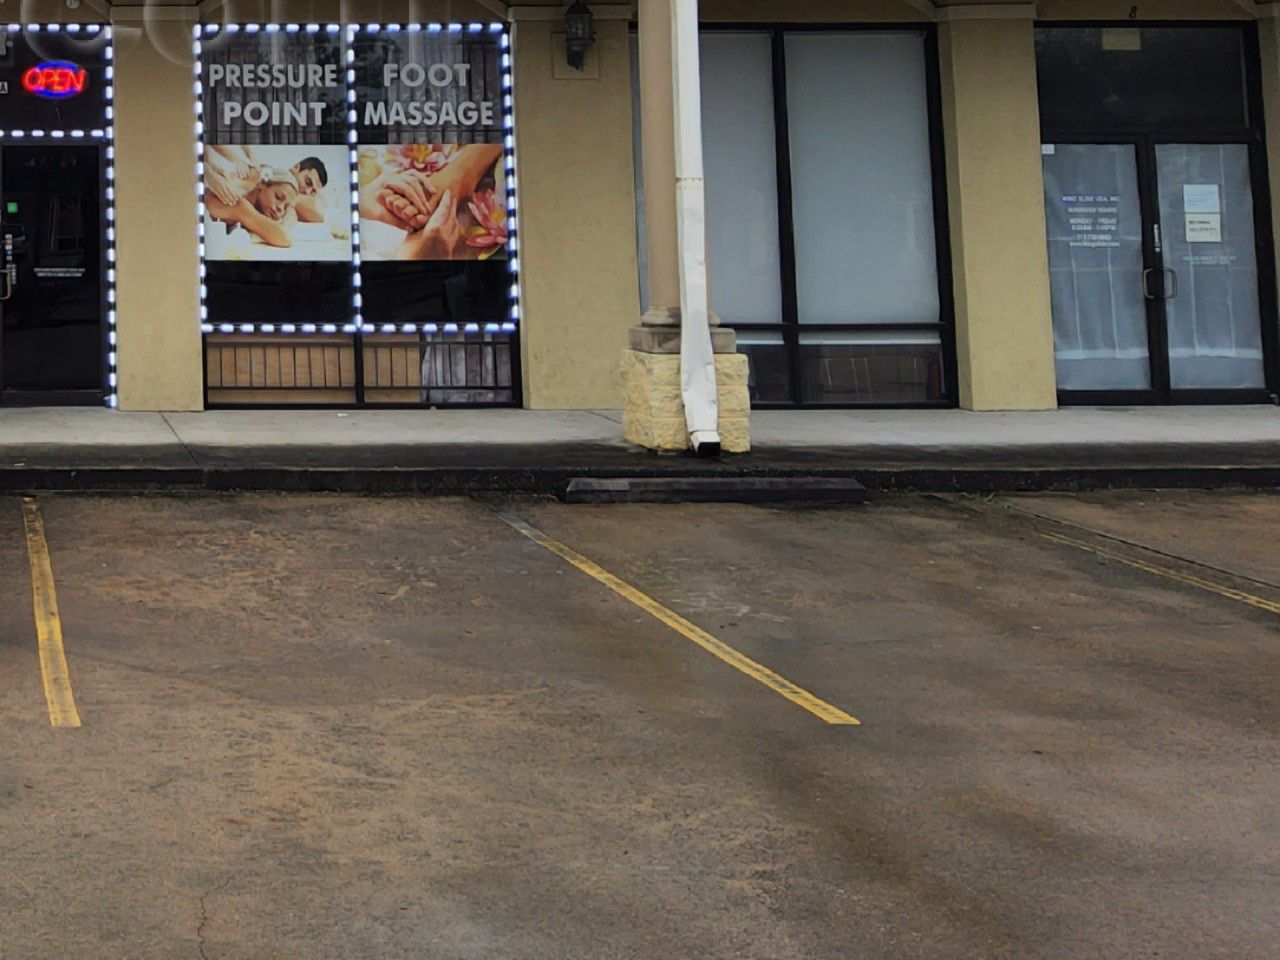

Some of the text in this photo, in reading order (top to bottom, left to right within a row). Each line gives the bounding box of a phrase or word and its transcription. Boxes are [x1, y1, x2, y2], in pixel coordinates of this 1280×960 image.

[23, 66, 87, 94] OPEN
[209, 63, 338, 88] PRESSURE
[383, 63, 471, 87] FOOT
[223, 101, 327, 126] POINT
[363, 101, 494, 126] MASSAGE
